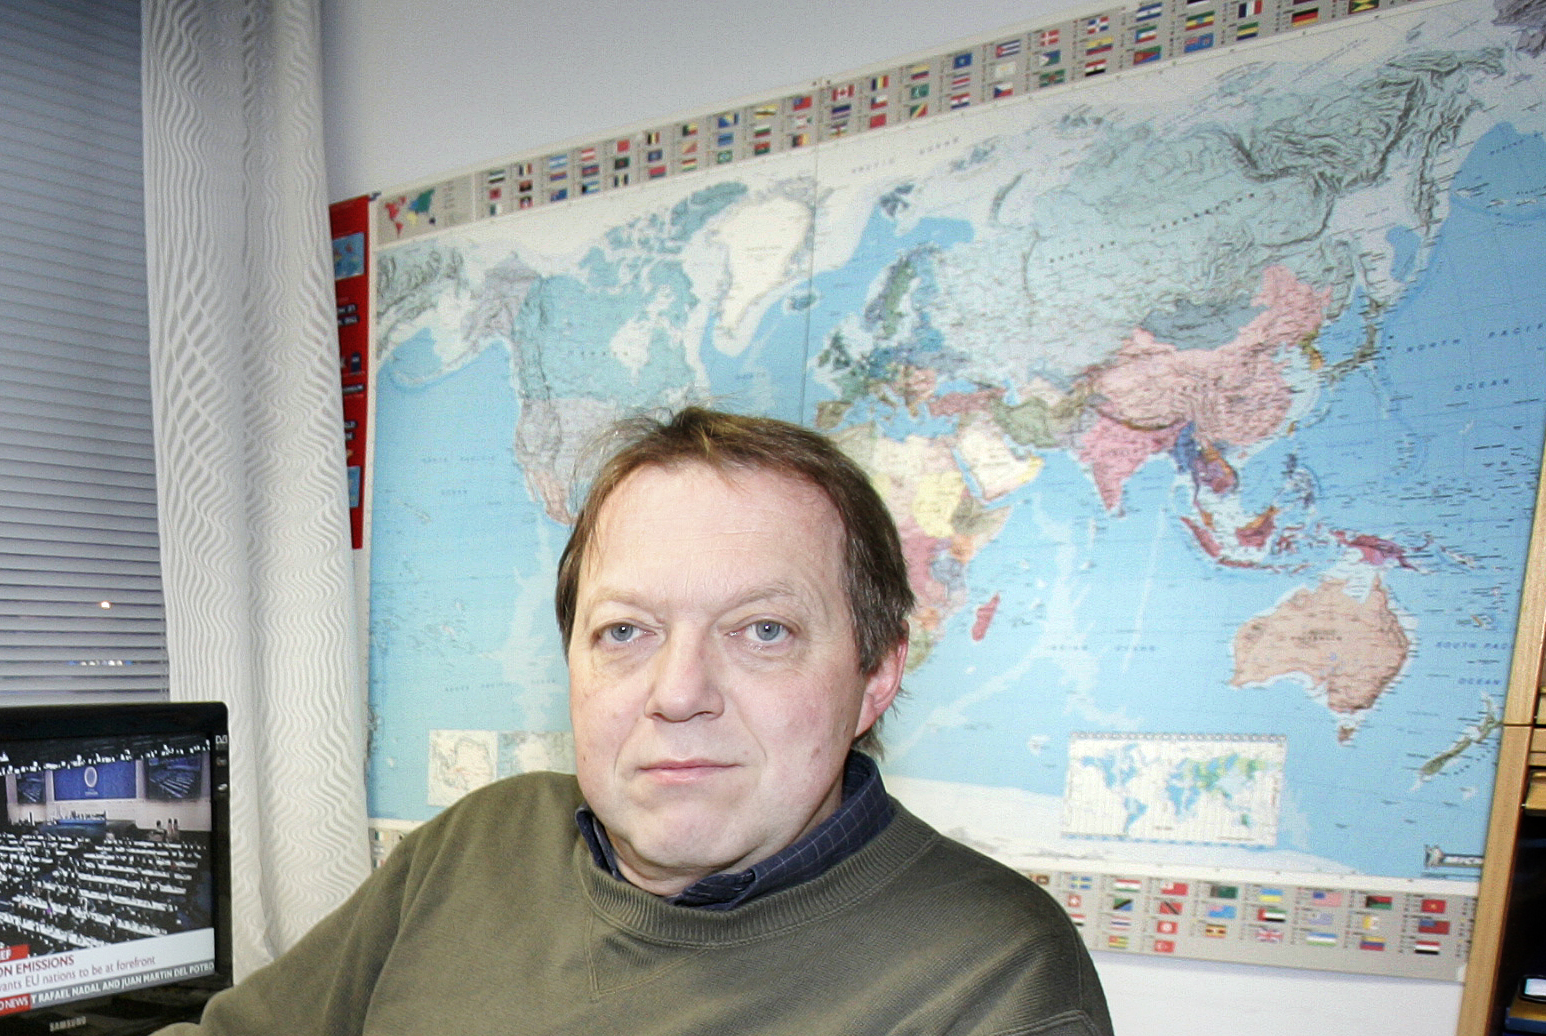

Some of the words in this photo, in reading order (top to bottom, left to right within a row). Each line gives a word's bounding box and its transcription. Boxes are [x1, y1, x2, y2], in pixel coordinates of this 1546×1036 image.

[16, 955, 75, 974] EMISSIONS
[25, 975, 40, 987] EU
[43, 969, 76, 985] nations
[79, 967, 90, 978] to
[91, 963, 103, 976] be
[105, 962, 114, 973] at
[116, 955, 156, 971] forefront
[5, 997, 29, 1009] NEWS
[38, 988, 71, 1003] RAFAEL
[72, 983, 102, 998] NADAL
[102, 979, 120, 991] AND
[121, 974, 142, 989] JUAN
[144, 968, 173, 984] MARTIN
[174, 965, 189, 978] DEL
[50, 1016, 87, 1032] SAMSUNG
